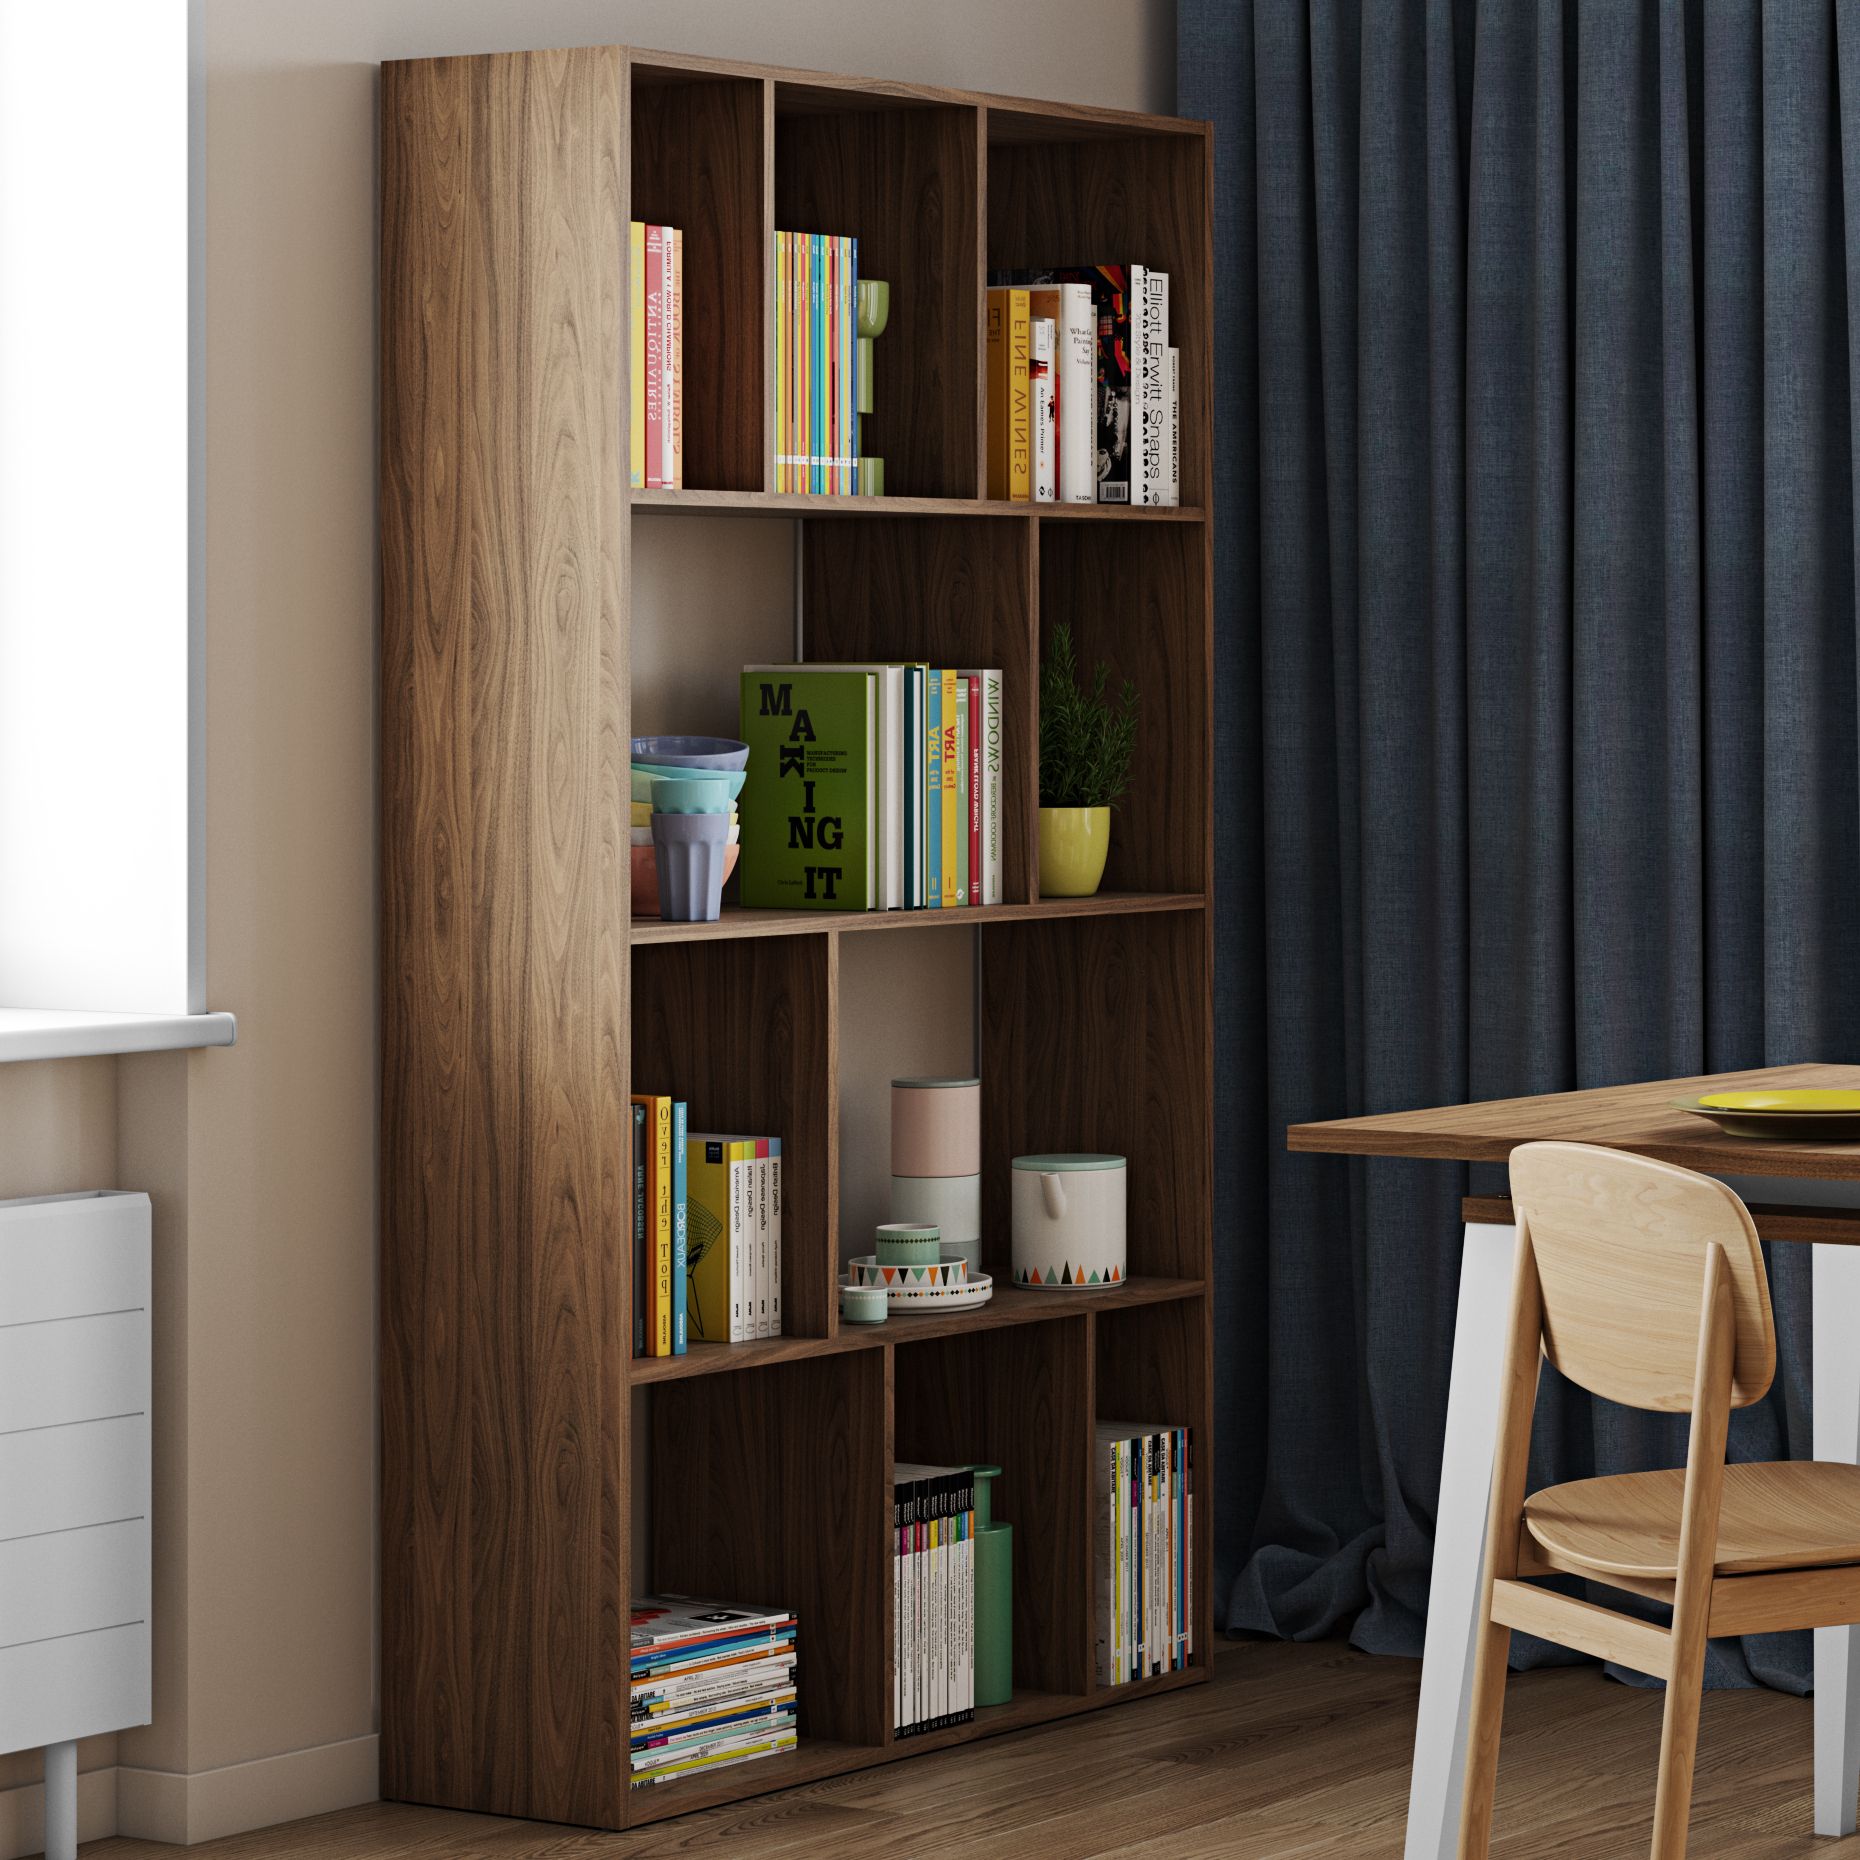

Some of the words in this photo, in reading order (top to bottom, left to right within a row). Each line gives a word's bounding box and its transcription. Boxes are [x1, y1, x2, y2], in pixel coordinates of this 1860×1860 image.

[1150, 278, 1163, 334] Elliott
[1040, 387, 1045, 398] An
[1150, 343, 1163, 402] Erwitt
[1148, 410, 1163, 478] Snaps
[804, 866, 842, 899] IT
